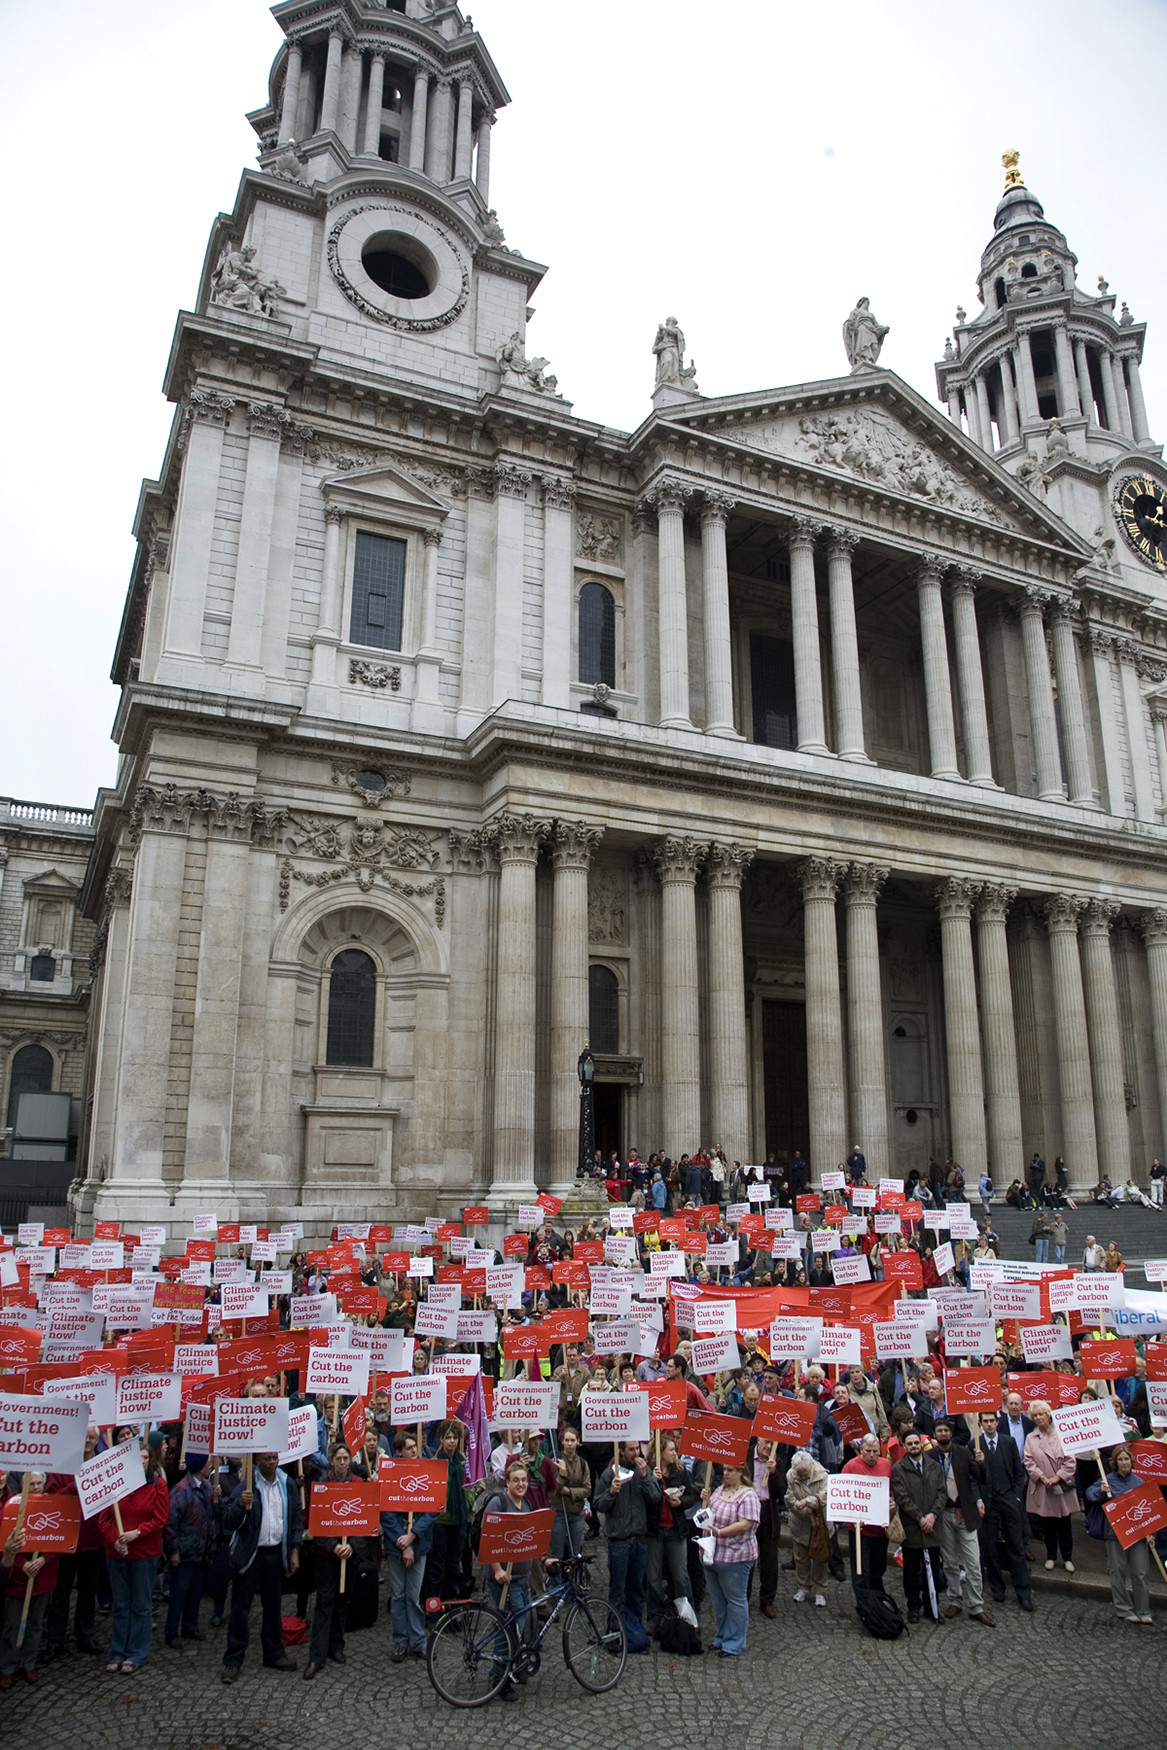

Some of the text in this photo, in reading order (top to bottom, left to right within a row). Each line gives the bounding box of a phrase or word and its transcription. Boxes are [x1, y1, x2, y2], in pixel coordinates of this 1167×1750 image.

[833, 1257, 863, 1265] Government!
[487, 1266, 519, 1274] Government!
[835, 1272, 858, 1280] carbon
[224, 1285, 260, 1294] Climate
[488, 1281, 512, 1289] carbon
[224, 1295, 255, 1304] justice
[293, 1296, 328, 1305] Government!
[1051, 1297, 1068, 1305] now!
[110, 1305, 125, 1313] Cut
[224, 1303, 248, 1311] now!
[293, 1305, 308, 1313] Cut
[420, 1305, 455, 1314] Government!
[52, 1312, 95, 1322] Climate
[109, 1314, 138, 1322] carbon
[419, 1312, 432, 1320] Cut
[1115, 1310, 1162, 1324] iberal
[49, 1322, 86, 1331] justice
[417, 1321, 444, 1330] carbon
[352, 1330, 398, 1339] Government!
[597, 1331, 614, 1339] Cut
[877, 1333, 894, 1341] Cut
[1022, 1328, 1061, 1338] Climate
[351, 1338, 388, 1349] Cut the
[597, 1340, 626, 1348] carbon
[694, 1340, 729, 1353] Climate
[878, 1342, 911, 1350] carbon
[1024, 1338, 1057, 1348] justice
[312, 1351, 364, 1360] Government!
[695, 1350, 725, 1361] justice
[1026, 1346, 1051, 1355] now!
[46, 1354, 66, 1362] Cut
[432, 1356, 472, 1365] Climate
[696, 1357, 719, 1368] now!
[177, 1359, 213, 1368] justice
[311, 1361, 352, 1371] Cut the
[431, 1365, 465, 1375] justice
[121, 1378, 172, 1390] Climate
[310, 1374, 349, 1384] carbon
[394, 1379, 441, 1389] Government!
[47, 1379, 108, 1393] Government!
[120, 1390, 163, 1404] justice
[394, 1390, 432, 1401] Cut the
[585, 1396, 641, 1404] Government!
[500, 1396, 542, 1406] Cut the
[119, 1401, 152, 1414] now!
[219, 1402, 277, 1415] Climate
[394, 1402, 429, 1414] carbon
[585, 1408, 630, 1417] Cut the
[1055, 1403, 1107, 1421] Government!
[500, 1409, 538, 1418] carbon
[0, 1417, 59, 1435] ut the
[218, 1416, 267, 1429] justice
[585, 1421, 628, 1430] carbon
[1058, 1417, 1100, 1432] Cut the
[218, 1428, 254, 1440] now!
[1063, 1429, 1102, 1445] carbon
[0, 1439, 50, 1454] arbon
[78, 1443, 132, 1478] Government!
[81, 1462, 124, 1491] Cut the
[830, 1477, 883, 1488] Government!
[84, 1477, 125, 1505] carbon
[830, 1488, 872, 1500] Cut the
[830, 1501, 869, 1513] carbon
